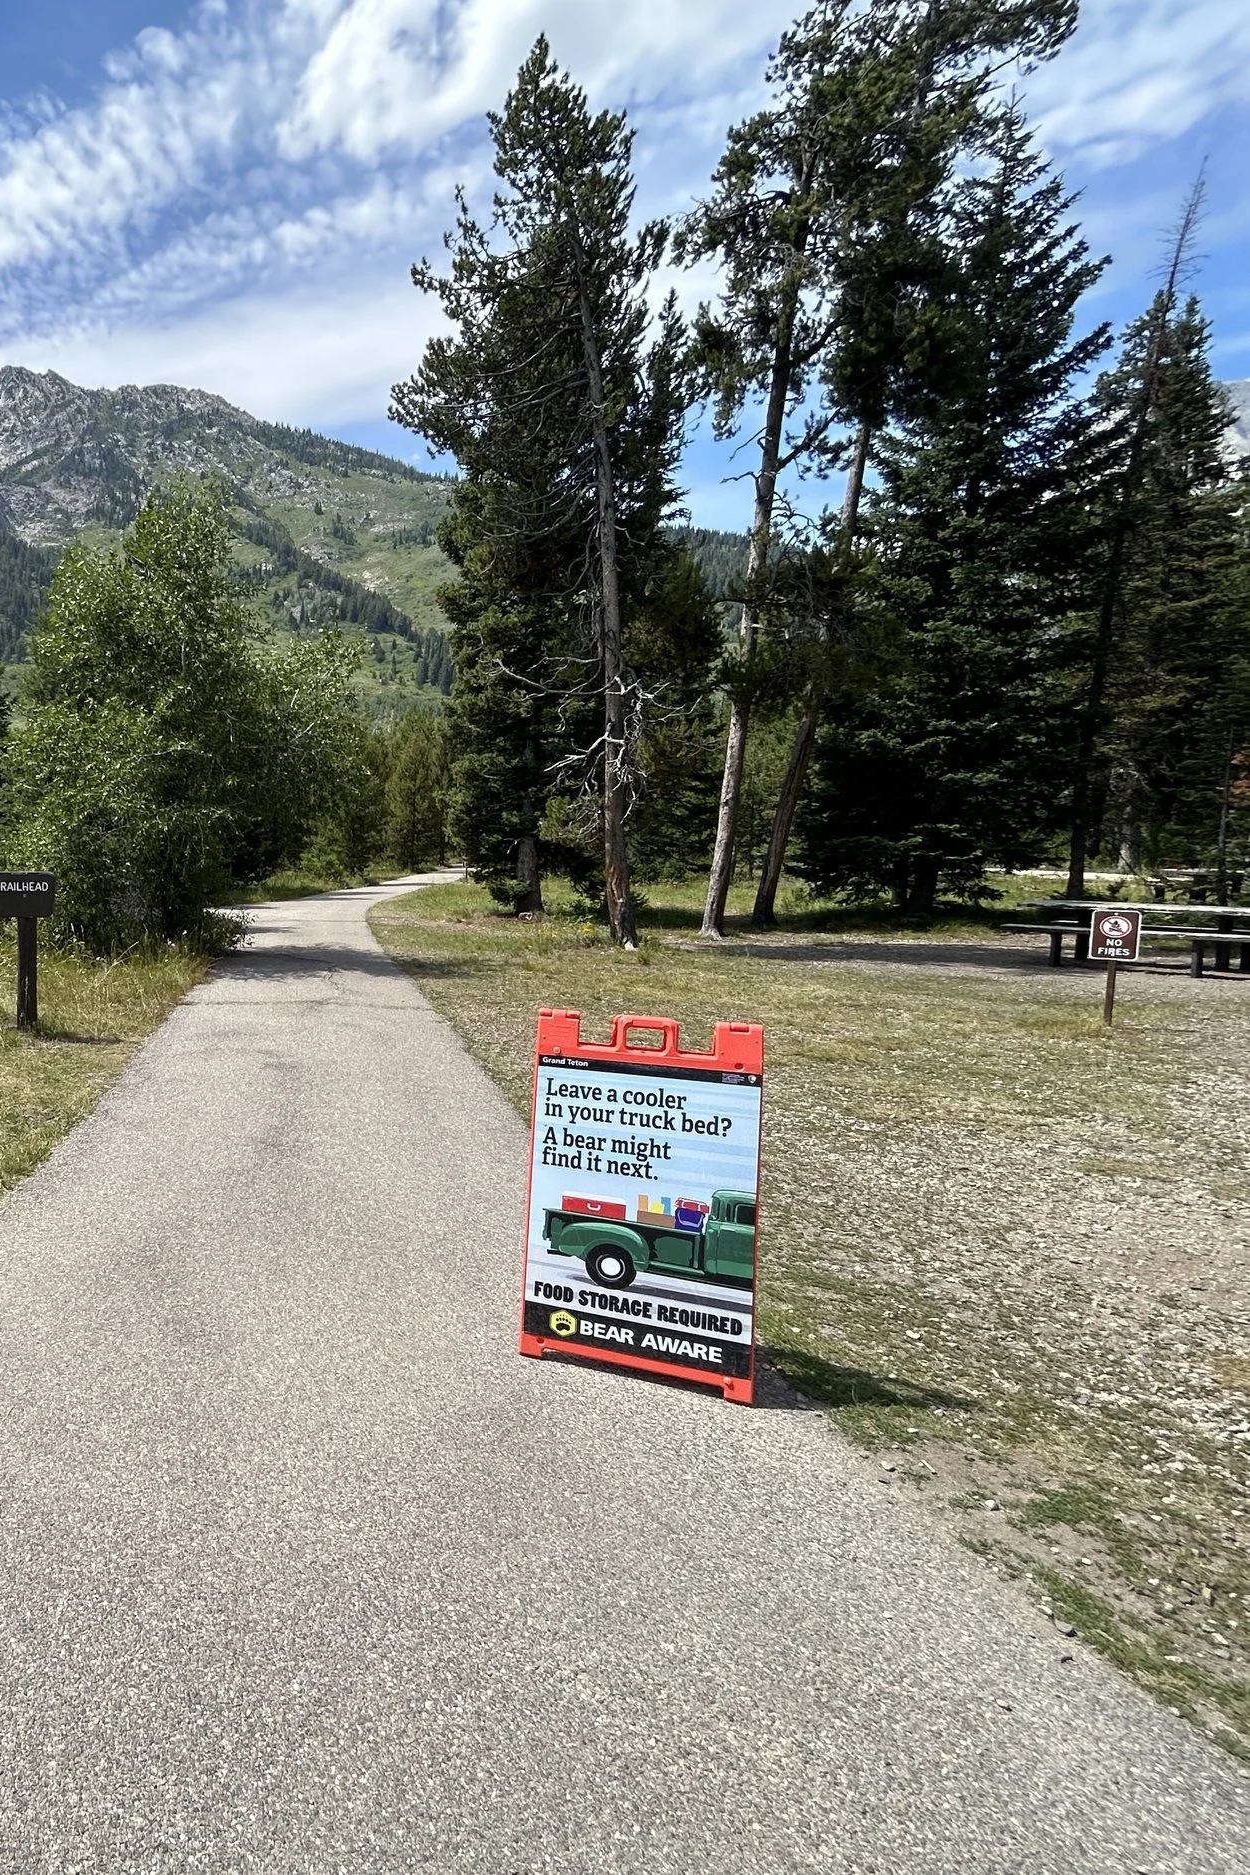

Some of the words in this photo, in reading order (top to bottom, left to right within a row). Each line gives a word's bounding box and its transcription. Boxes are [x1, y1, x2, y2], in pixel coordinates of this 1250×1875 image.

[1098, 947, 1130, 956] FIRES
[567, 1059, 588, 1067] Teton
[546, 1078, 602, 1101] Leave
[606, 1088, 618, 1103] a
[622, 1088, 687, 1110] cooler
[544, 1097, 563, 1117] in
[568, 1104, 615, 1124] your
[619, 1107, 676, 1131] truck
[681, 1112, 732, 1137] bed?
[543, 1126, 558, 1145] A
[563, 1128, 606, 1151] bear
[611, 1135, 671, 1162] might
[542, 1146, 582, 1169] find
[586, 1151, 602, 1172] it
[606, 1159, 658, 1180] next.
[534, 1281, 574, 1303] FOOD
[578, 1290, 651, 1319] STORAGE
[657, 1305, 743, 1336] REQUIRED
[579, 1320, 634, 1345] BEAR
[641, 1333, 723, 1364] AWARE
